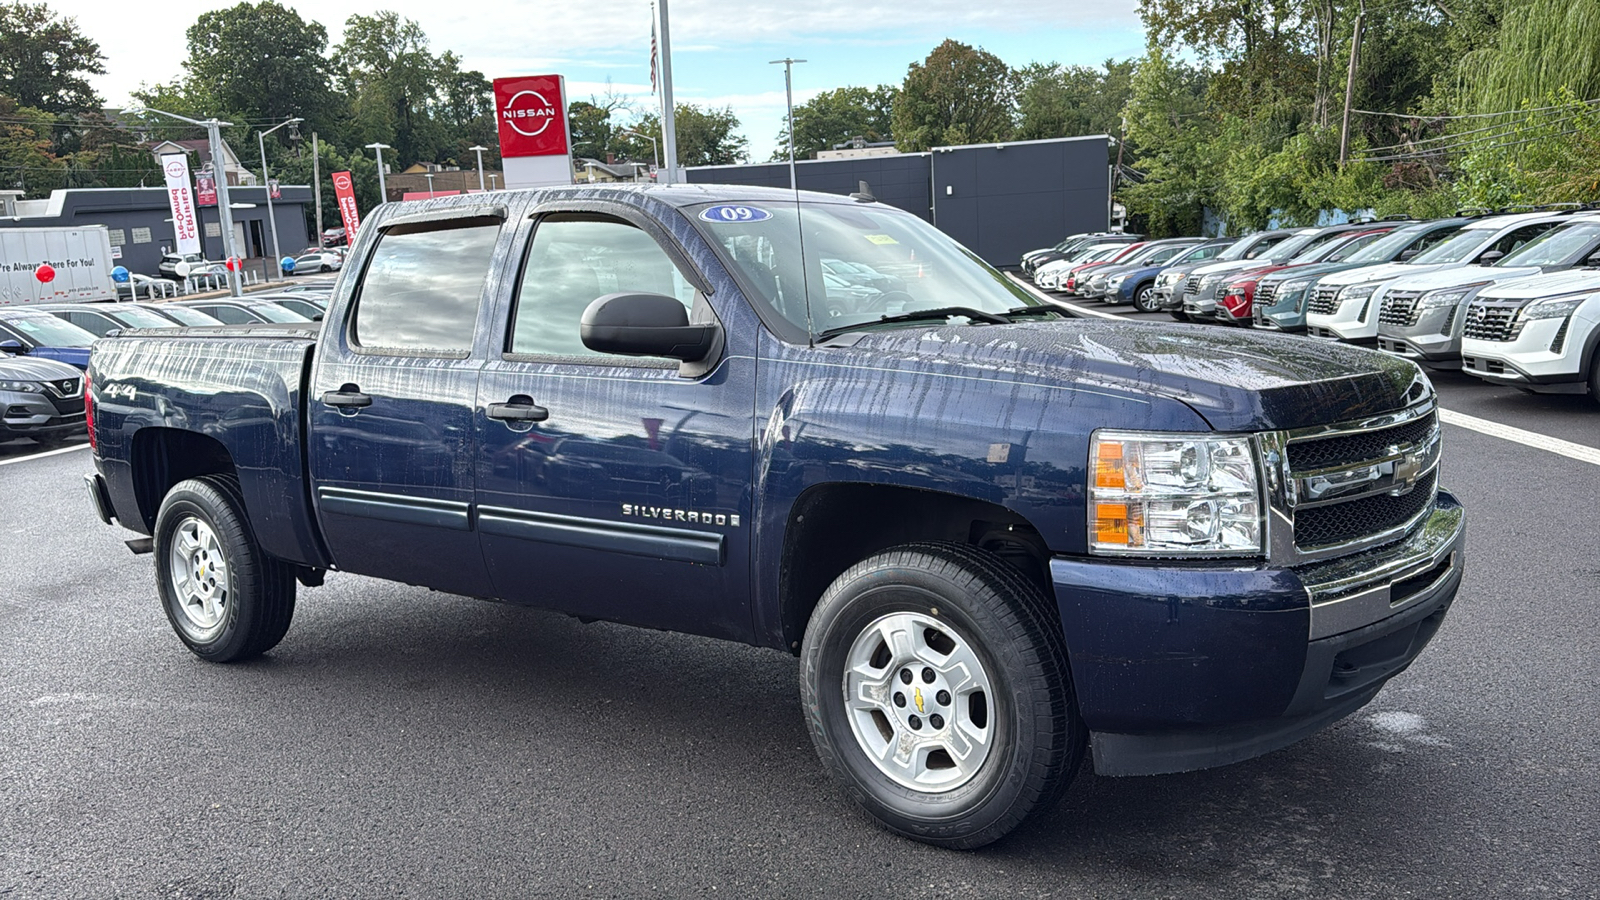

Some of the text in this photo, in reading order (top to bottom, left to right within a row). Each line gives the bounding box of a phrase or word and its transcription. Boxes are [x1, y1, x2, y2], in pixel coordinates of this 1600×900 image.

[502, 107, 555, 119] NISSAN
[720, 207, 753, 221] 09
[66, 259, 78, 268] For
[79, 257, 95, 267] You!
[622, 503, 726, 526] SILVERADO
